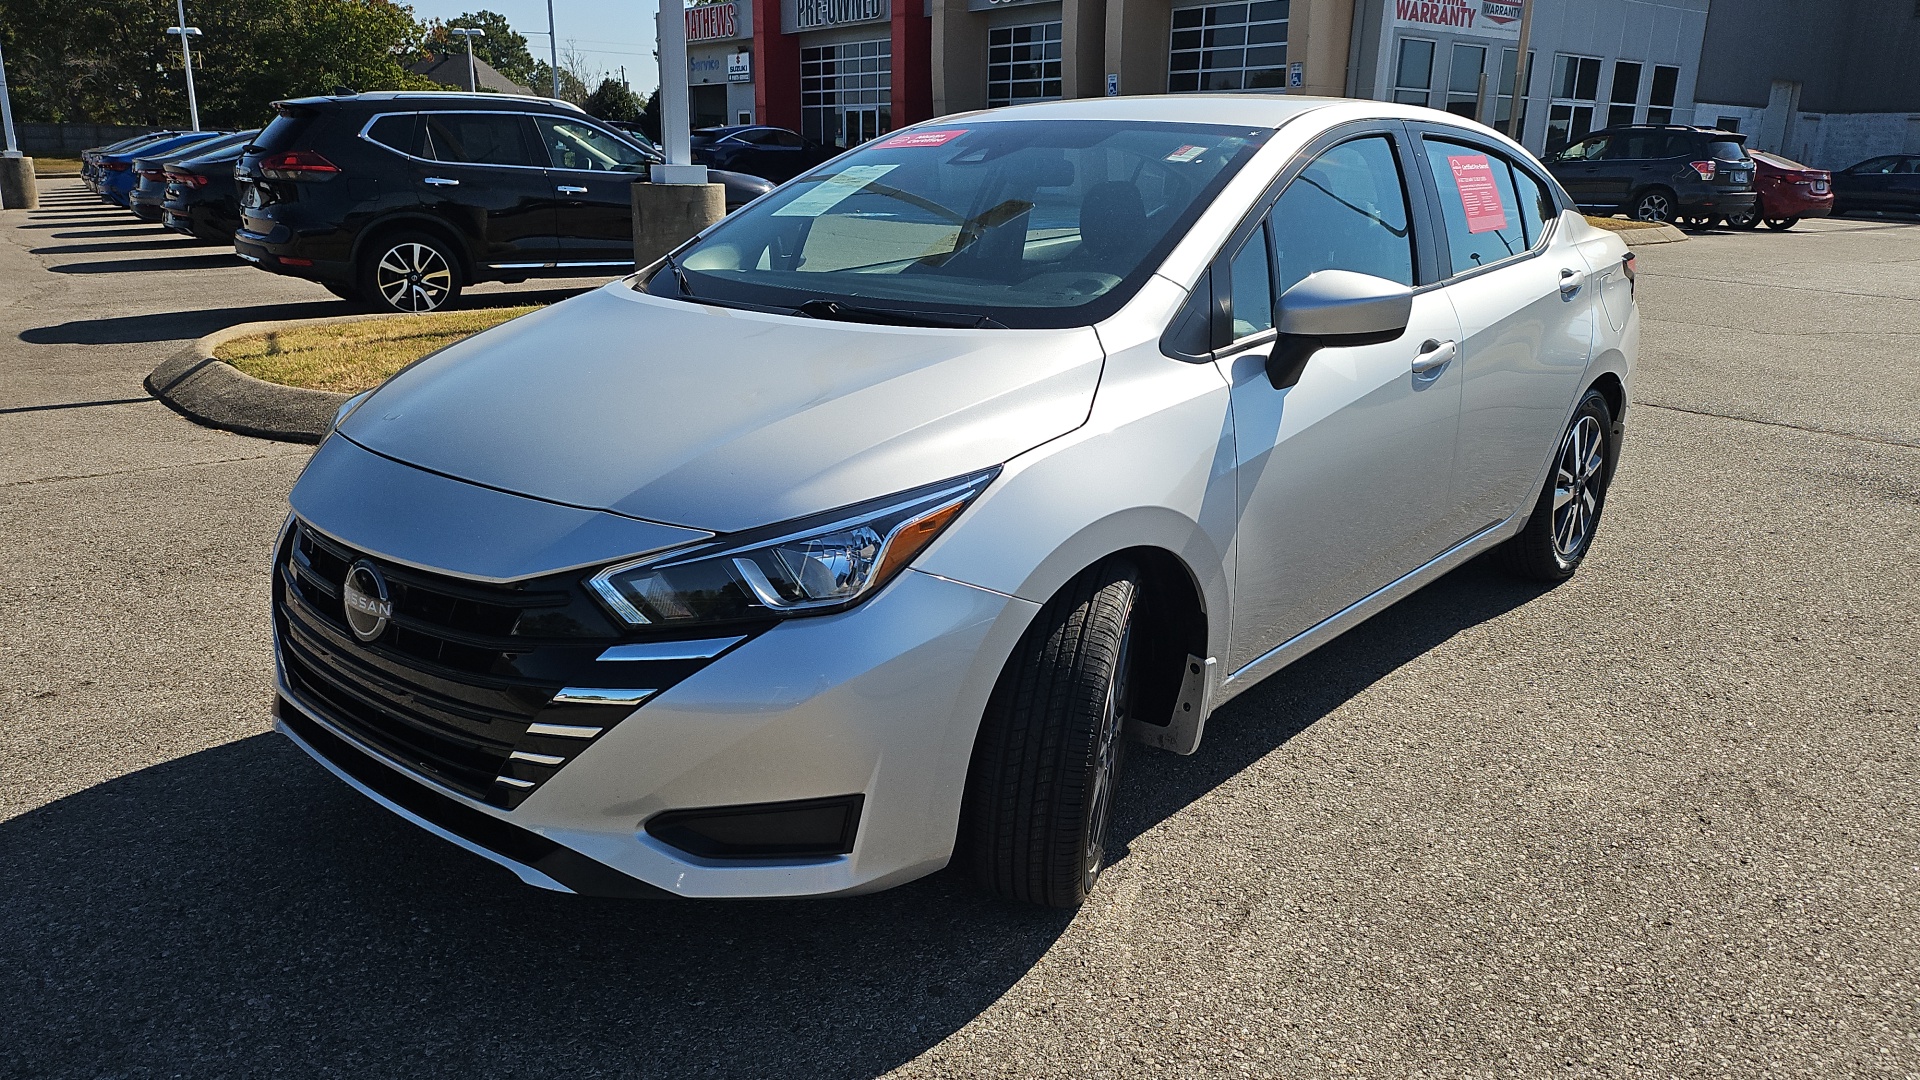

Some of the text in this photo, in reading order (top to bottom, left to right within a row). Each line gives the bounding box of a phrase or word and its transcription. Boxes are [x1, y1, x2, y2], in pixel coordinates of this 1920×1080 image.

[797, 0, 881, 28] PRE-OWNED
[1396, 1, 1477, 28] WARRANTY
[1483, 3, 1520, 18] WARRANTY
[691, 56, 720, 71] Service
[729, 65, 748, 73] SUZUKI
[345, 588, 391, 616] ISSAN
